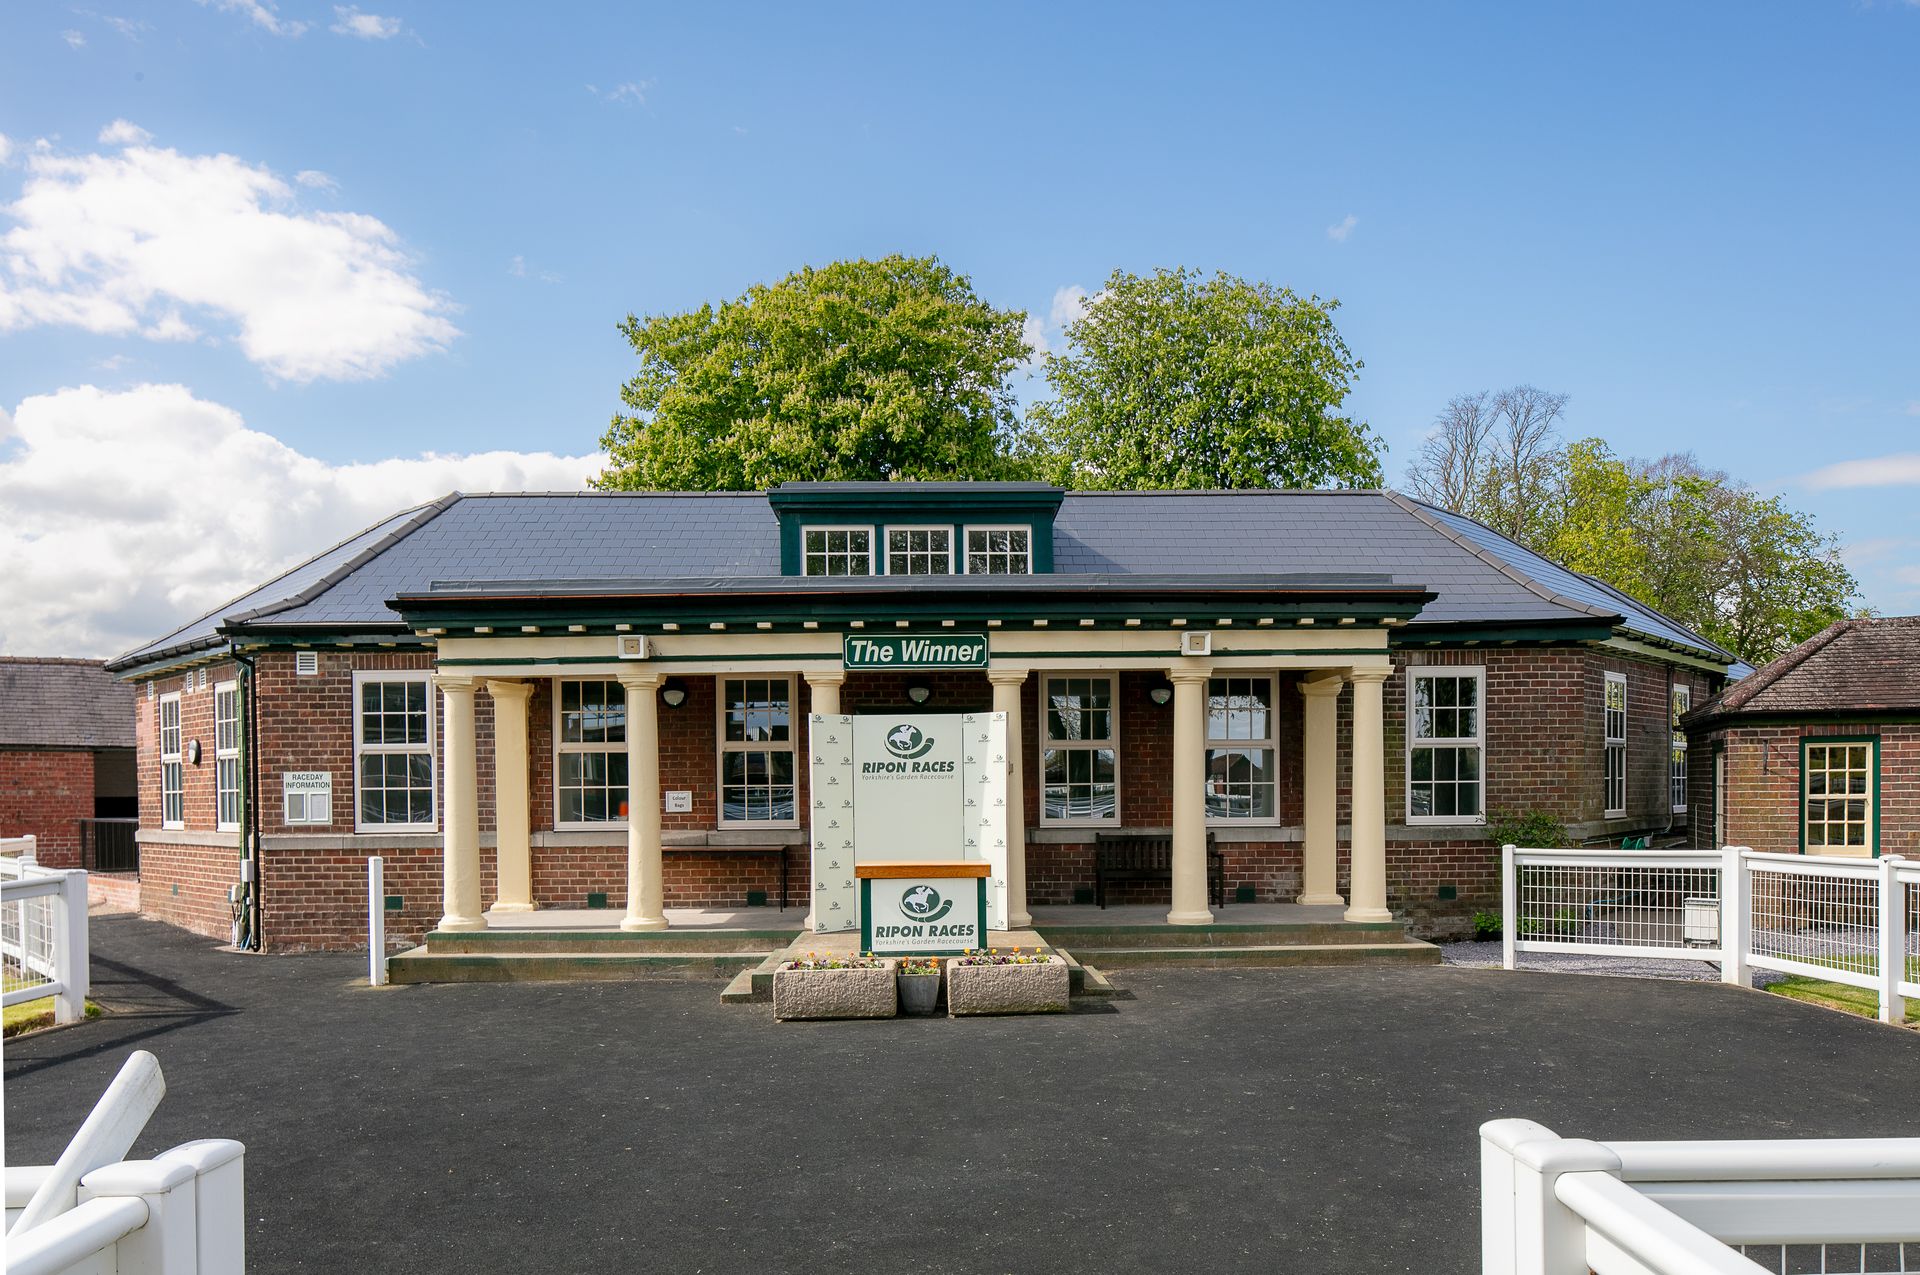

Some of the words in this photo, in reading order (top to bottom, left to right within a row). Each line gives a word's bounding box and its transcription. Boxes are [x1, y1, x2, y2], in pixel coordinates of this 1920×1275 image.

[851, 640, 894, 662] The
[901, 640, 983, 662] Winner
[862, 762, 907, 773] RIPON
[911, 761, 955, 773] RACES
[875, 925, 924, 938] RIPON
[928, 924, 975, 937] RACES
